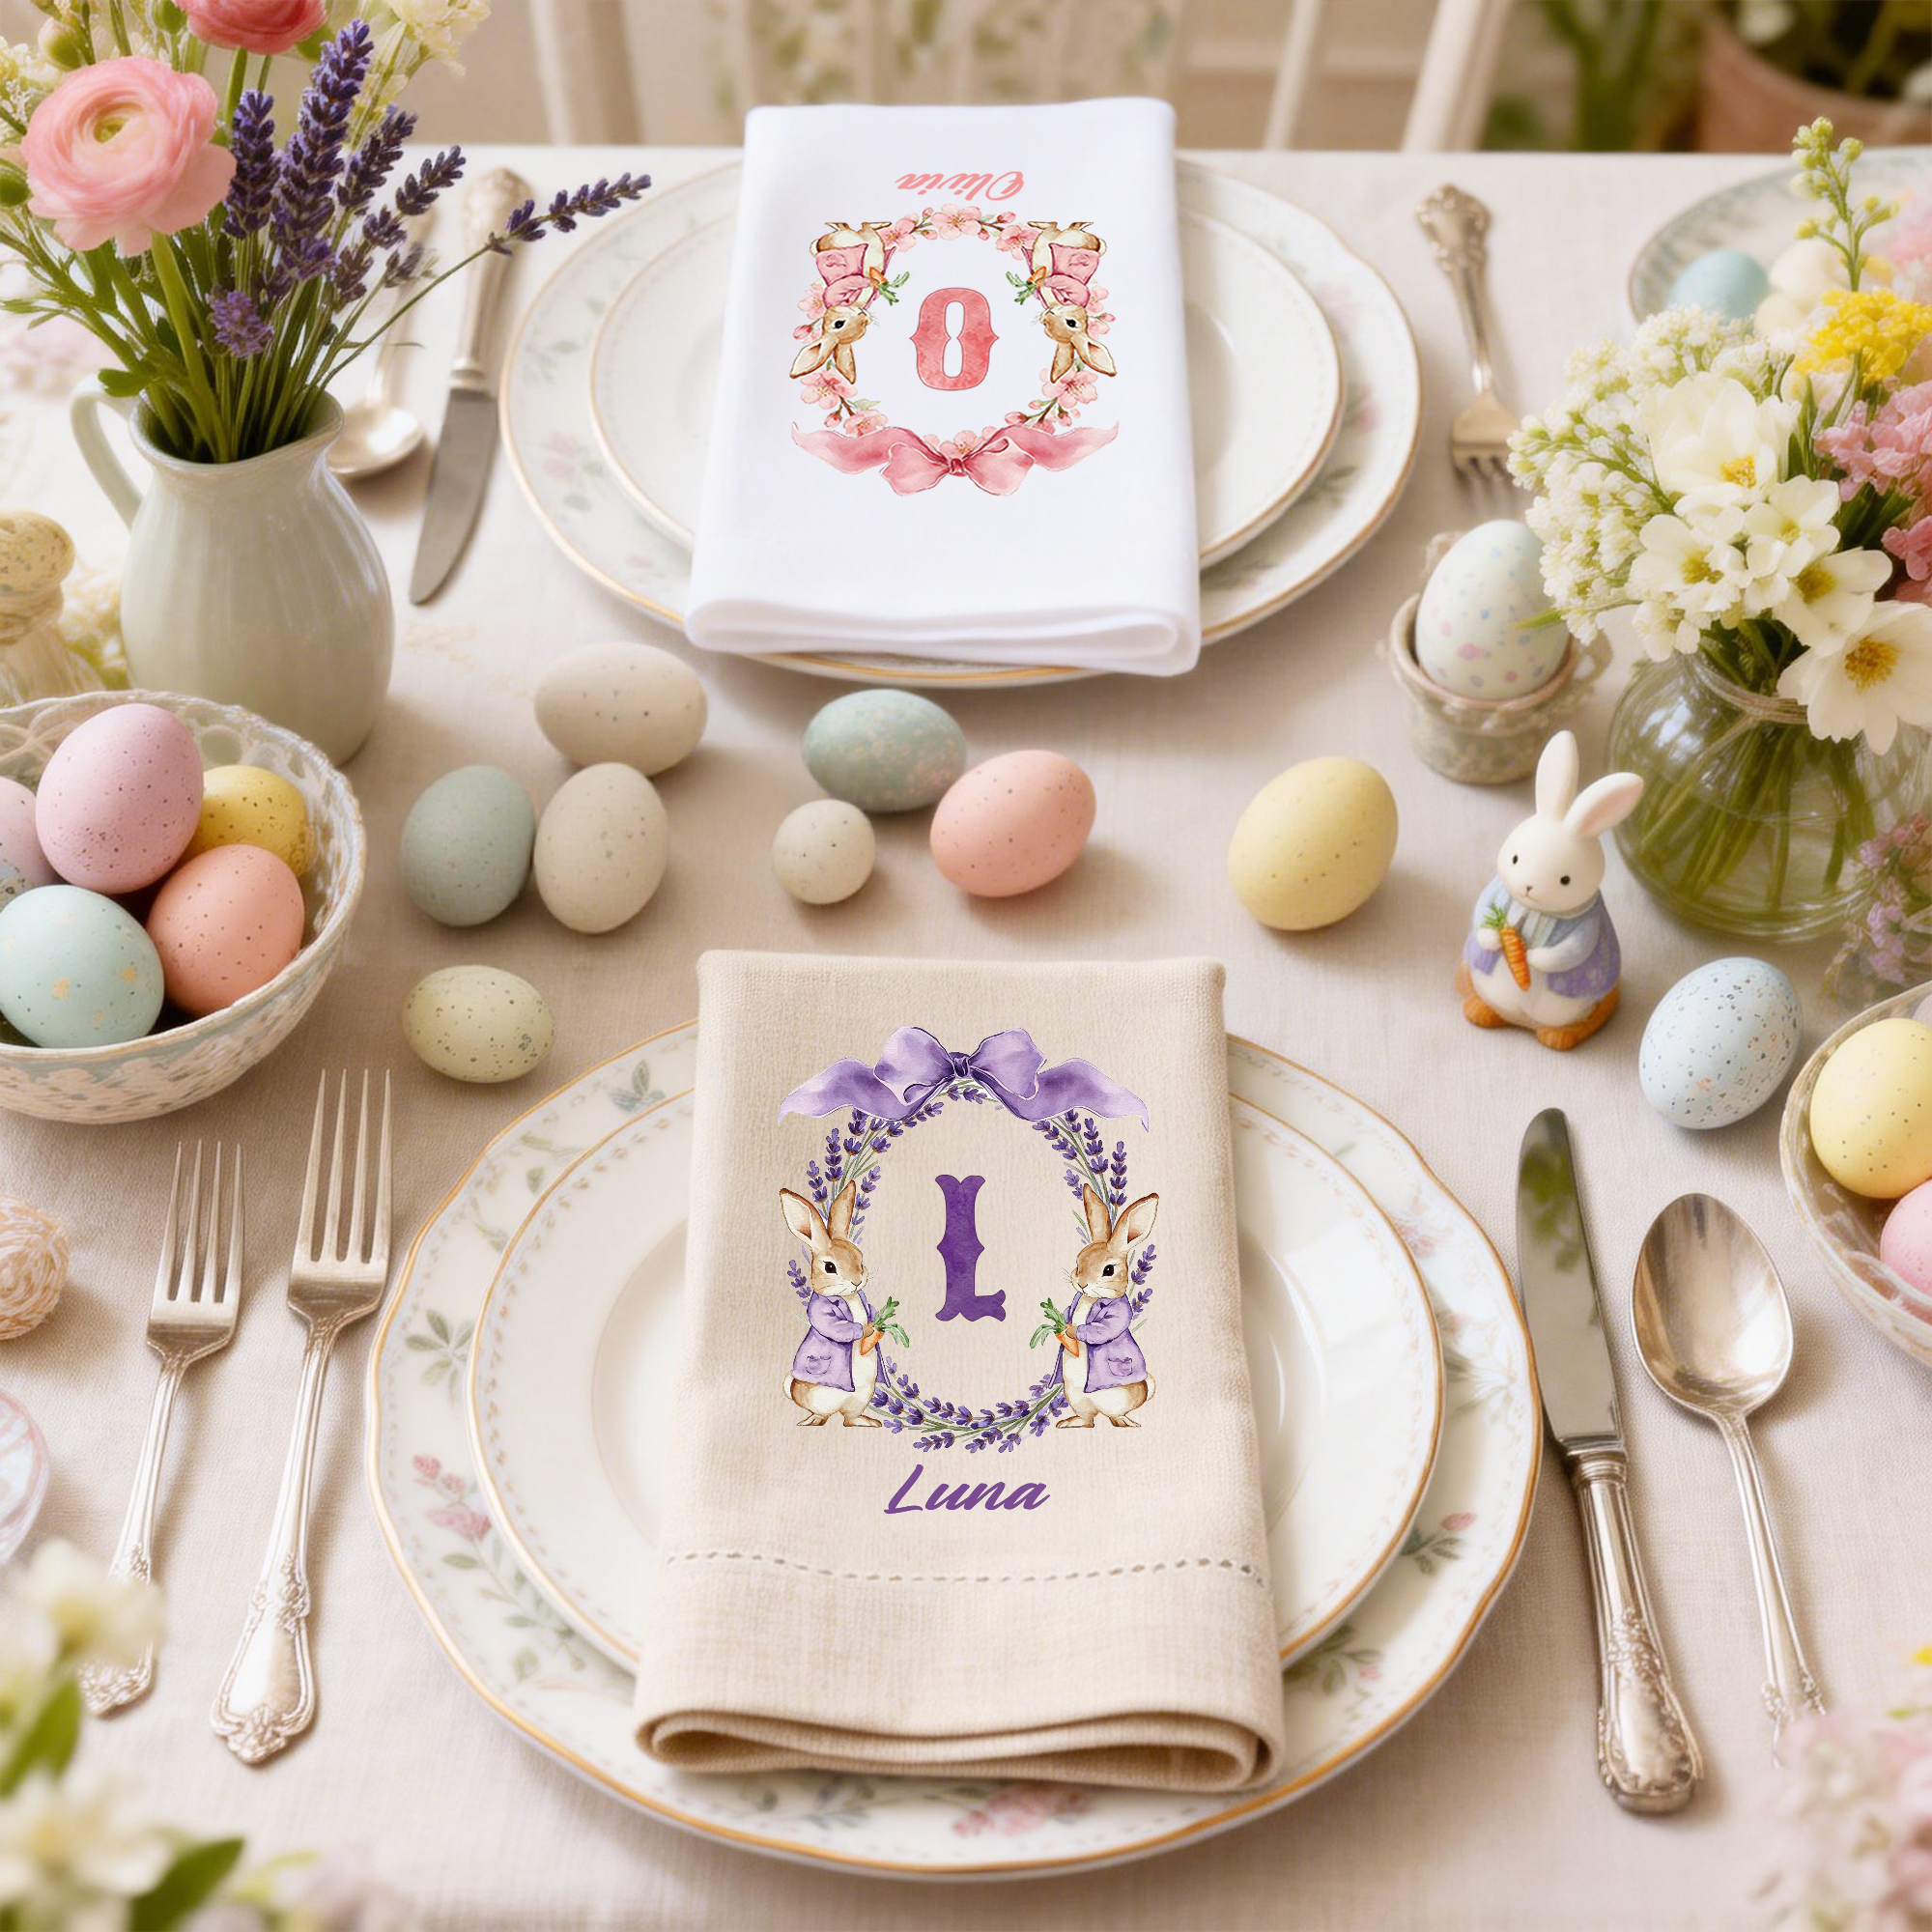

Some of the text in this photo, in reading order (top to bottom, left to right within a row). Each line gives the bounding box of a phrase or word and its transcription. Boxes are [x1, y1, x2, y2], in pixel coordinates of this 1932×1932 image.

[895, 170, 1025, 201] Olivia
[909, 287, 1000, 391] O
[934, 1174, 1007, 1322] L
[883, 1463, 1051, 1515] Luna
